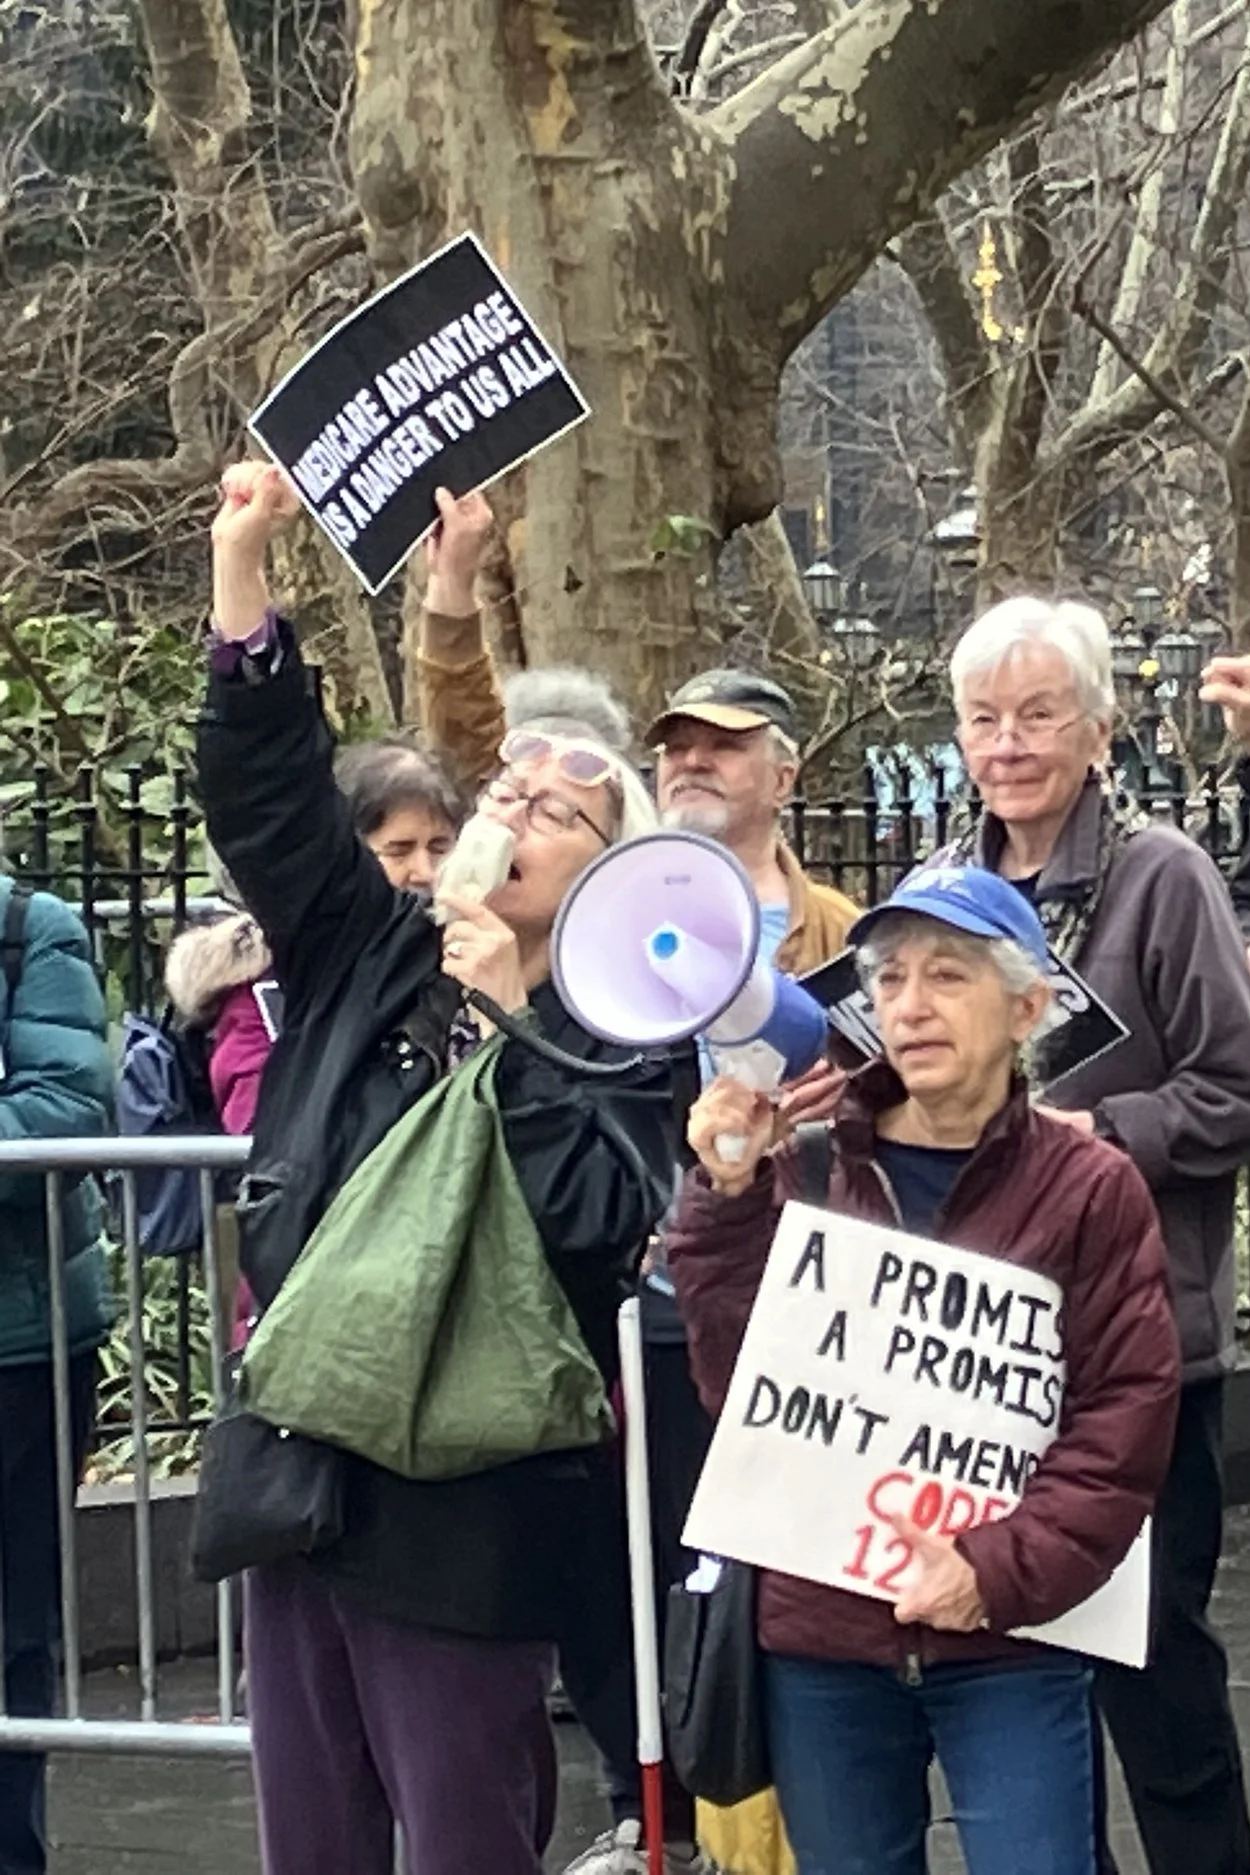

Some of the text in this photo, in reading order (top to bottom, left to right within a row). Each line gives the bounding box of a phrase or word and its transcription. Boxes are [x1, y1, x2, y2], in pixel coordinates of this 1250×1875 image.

[291, 291, 524, 504] MEDICARE ADVANTAGE
[321, 337, 557, 547] IS A DANGER TO US ALL
[789, 1231, 825, 1292] A
[817, 1310, 847, 1361] A
[743, 1375, 889, 1455] DON'T
[843, 1524, 914, 1593] 12
